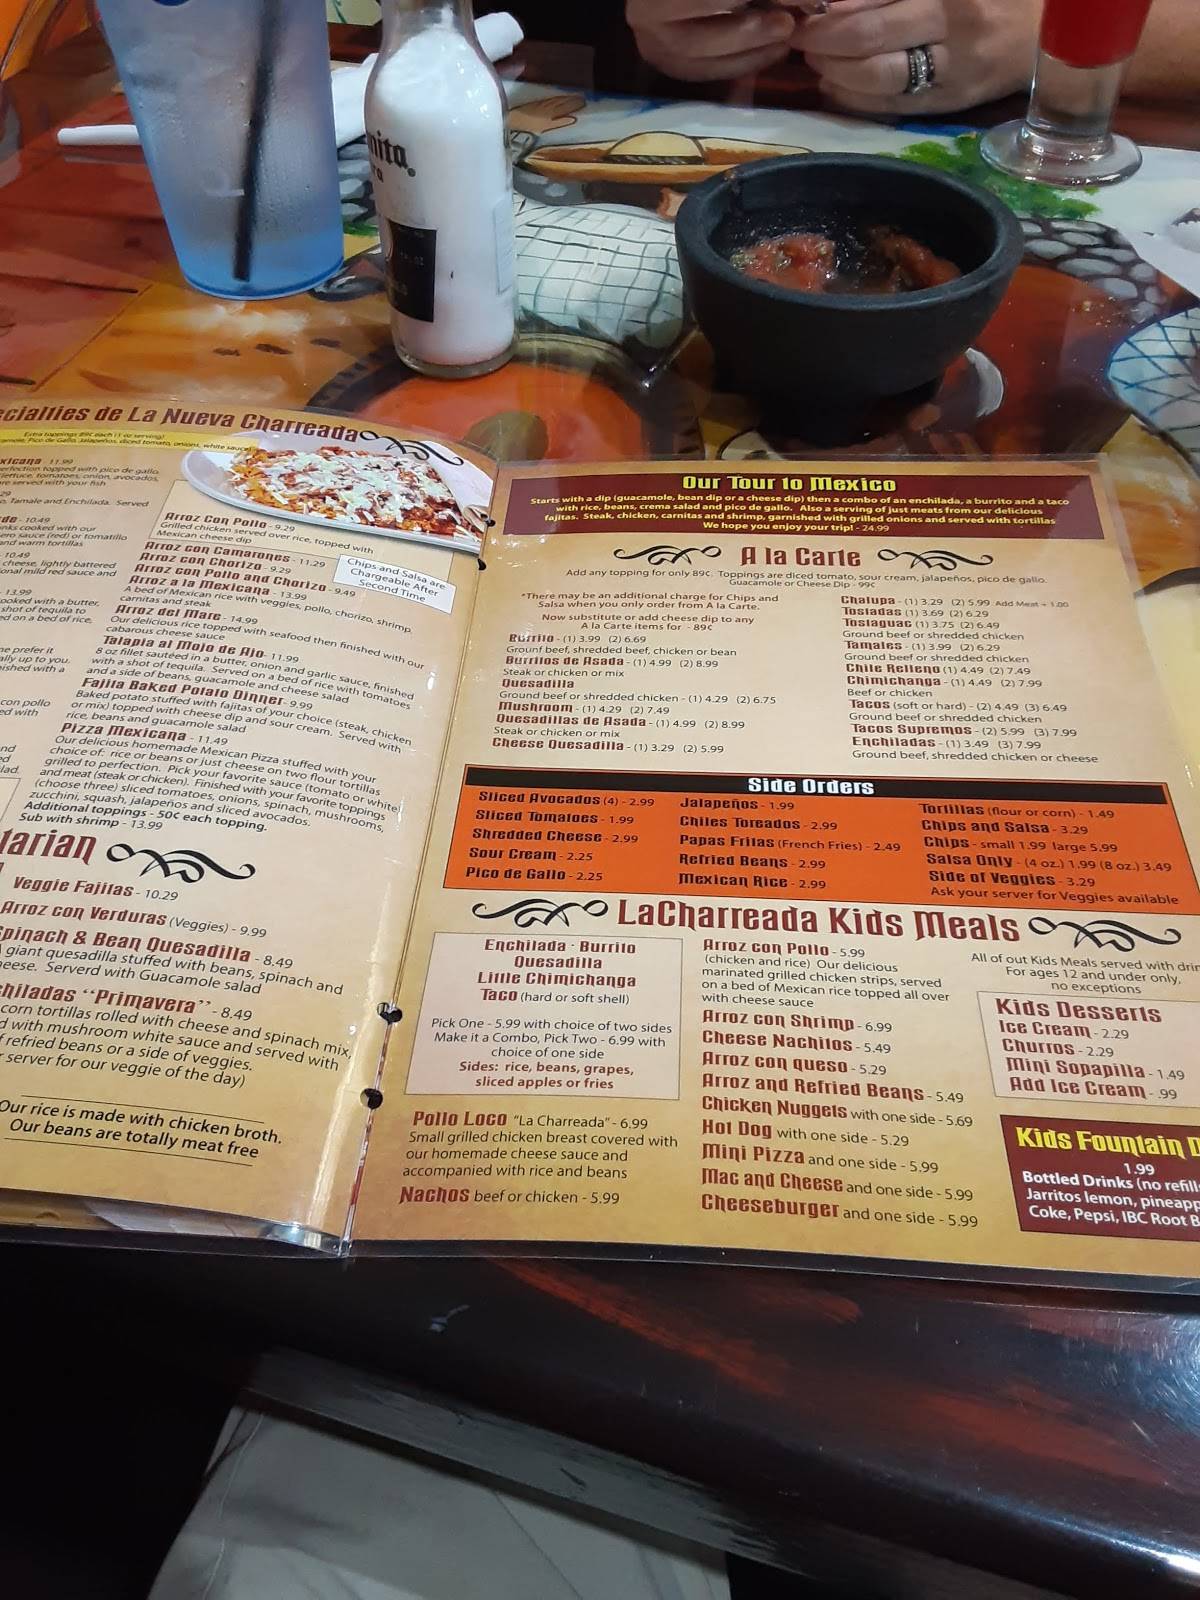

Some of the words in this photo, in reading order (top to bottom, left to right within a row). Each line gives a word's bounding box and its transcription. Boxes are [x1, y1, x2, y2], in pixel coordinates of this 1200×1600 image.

[94, 406, 123, 421] de
[127, 406, 157, 422] La
[160, 407, 235, 427] Nueva
[240, 413, 359, 443] Charreada
[682, 475, 721, 489] Our
[726, 475, 776, 490] Tour
[781, 476, 803, 490] to
[809, 476, 896, 492] Mexico
[702, 521, 719, 529] We
[721, 521, 748, 531] hope
[750, 523, 770, 531] you
[772, 522, 802, 532] enjoy
[803, 524, 829, 532] your
[862, 524, 889, 532] 24.99
[740, 546, 756, 566] A
[764, 546, 787, 565] la
[795, 547, 861, 567] Carte
[347, 558, 376, 569] Chips
[380, 565, 400, 575] and
[402, 570, 427, 583] Salsa
[429, 580, 446, 590] are
[350, 568, 411, 588] Chargeable
[413, 583, 439, 597] After
[359, 580, 398, 594] Second
[400, 589, 426, 602] Time
[541, 613, 566, 623] Now
[568, 612, 622, 621] substitute
[638, 613, 659, 621] add
[661, 613, 698, 624] cheese
[700, 614, 718, 624] dip
[734, 616, 754, 625] any
[155, 627, 193, 638] cheese
[194, 632, 225, 641] sauce
[501, 678, 574, 688] Quesadilla
[847, 688, 872, 696] Beef
[874, 689, 887, 697] or
[889, 688, 933, 697] chicken
[852, 749, 897, 759] Ground
[931, 751, 988, 761] shredded
[990, 751, 1037, 762] chicken
[1040, 754, 1053, 762] or
[1055, 753, 1098, 763] cheese
[748, 777, 796, 793] Side
[802, 778, 874, 795] Orders
[190, 803, 214, 812] and
[215, 806, 251, 817] sliced
[921, 819, 967, 832] Chips
[970, 821, 1000, 834] and
[1004, 821, 1050, 833] Salsa
[1060, 825, 1088, 835] 3.29
[13, 876, 70, 893] Veggie
[72, 879, 134, 897] Fajitas
[145, 889, 178, 901] 10.29
[930, 886, 956, 897] Ask
[957, 889, 989, 899] your
[991, 890, 1034, 901] server
[1036, 889, 1057, 901] for
[1058, 890, 1114, 904] Veggies
[1117, 893, 1178, 905] available
[0, 900, 49, 916] Arroz
[51, 905, 85, 921] con
[90, 906, 167, 926] Verduras
[169, 916, 229, 934] (Veggies)
[239, 925, 267, 938] 9.99
[617, 900, 818, 933] LaCharreada
[828, 907, 903, 937] Kids
[911, 910, 1021, 942] Meals
[484, 938, 566, 952] Enchilada
[579, 940, 636, 954] Burrito
[514, 955, 602, 969] Quesadilla
[477, 971, 521, 984] Little
[525, 972, 636, 989] Chimichanga
[1005, 965, 1026, 976] For
[1029, 969, 1059, 980] ages
[1062, 968, 1078, 979] 12
[1080, 970, 1106, 980] and
[1108, 971, 1147, 982] under
[1150, 972, 1181, 986] only,
[480, 988, 518, 1001] Taco
[520, 991, 552, 1003] (hard
[555, 994, 568, 1002] or
[571, 992, 595, 1003] soft
[597, 993, 629, 1006] shell)
[1050, 982, 1068, 991] no
[1071, 983, 1142, 995] exceptions
[701, 992, 729, 1003] with
[731, 993, 775, 1006] cheese
[778, 998, 814, 1008] sauce
[994, 997, 1050, 1017] Kids
[1055, 1000, 1162, 1023] Desserts
[1001, 1038, 1075, 1055] Churros
[1086, 1046, 1114, 1058] 2.29
[459, 1060, 498, 1072] Sides:
[505, 1061, 532, 1073] rice,
[536, 1061, 580, 1074] beans,
[583, 1065, 634, 1077] grapes,
[475, 1075, 514, 1087] sliced
[517, 1076, 562, 1090] apples
[565, 1079, 581, 1088] or
[583, 1077, 614, 1089] fries
[0, 1099, 28, 1114] Our
[29, 1105, 60, 1117] rice
[62, 1108, 76, 1118] is
[78, 1109, 125, 1123] made
[129, 1113, 164, 1127] with
[168, 1116, 230, 1135] chicken
[233, 1123, 281, 1144] broth.
[9, 1118, 41, 1133] Our
[42, 1119, 92, 1138] beans
[95, 1128, 122, 1141] are
[126, 1130, 179, 1150] totally
[181, 1138, 224, 1153] meat
[227, 1140, 259, 1158] free
[408, 1130, 444, 1143] Small
[447, 1129, 489, 1146] grilled
[491, 1130, 542, 1143] chicken
[546, 1131, 588, 1144] breast
[590, 1133, 644, 1146] covered
[648, 1135, 678, 1148] with
[1015, 1126, 1072, 1150] Kids
[1075, 1130, 1186, 1160] Fountain
[402, 1163, 493, 1179] accompanied
[495, 1163, 525, 1176] with
[529, 1164, 553, 1177] rice
[556, 1164, 583, 1177] and
[586, 1164, 627, 1179] beans
[1123, 1162, 1155, 1176] 1.99
[1028, 1204, 1071, 1221] Coke,
[1073, 1207, 1119, 1224] Pepsi,
[1121, 1210, 1148, 1224] IBC
[1150, 1212, 1188, 1226] Root
